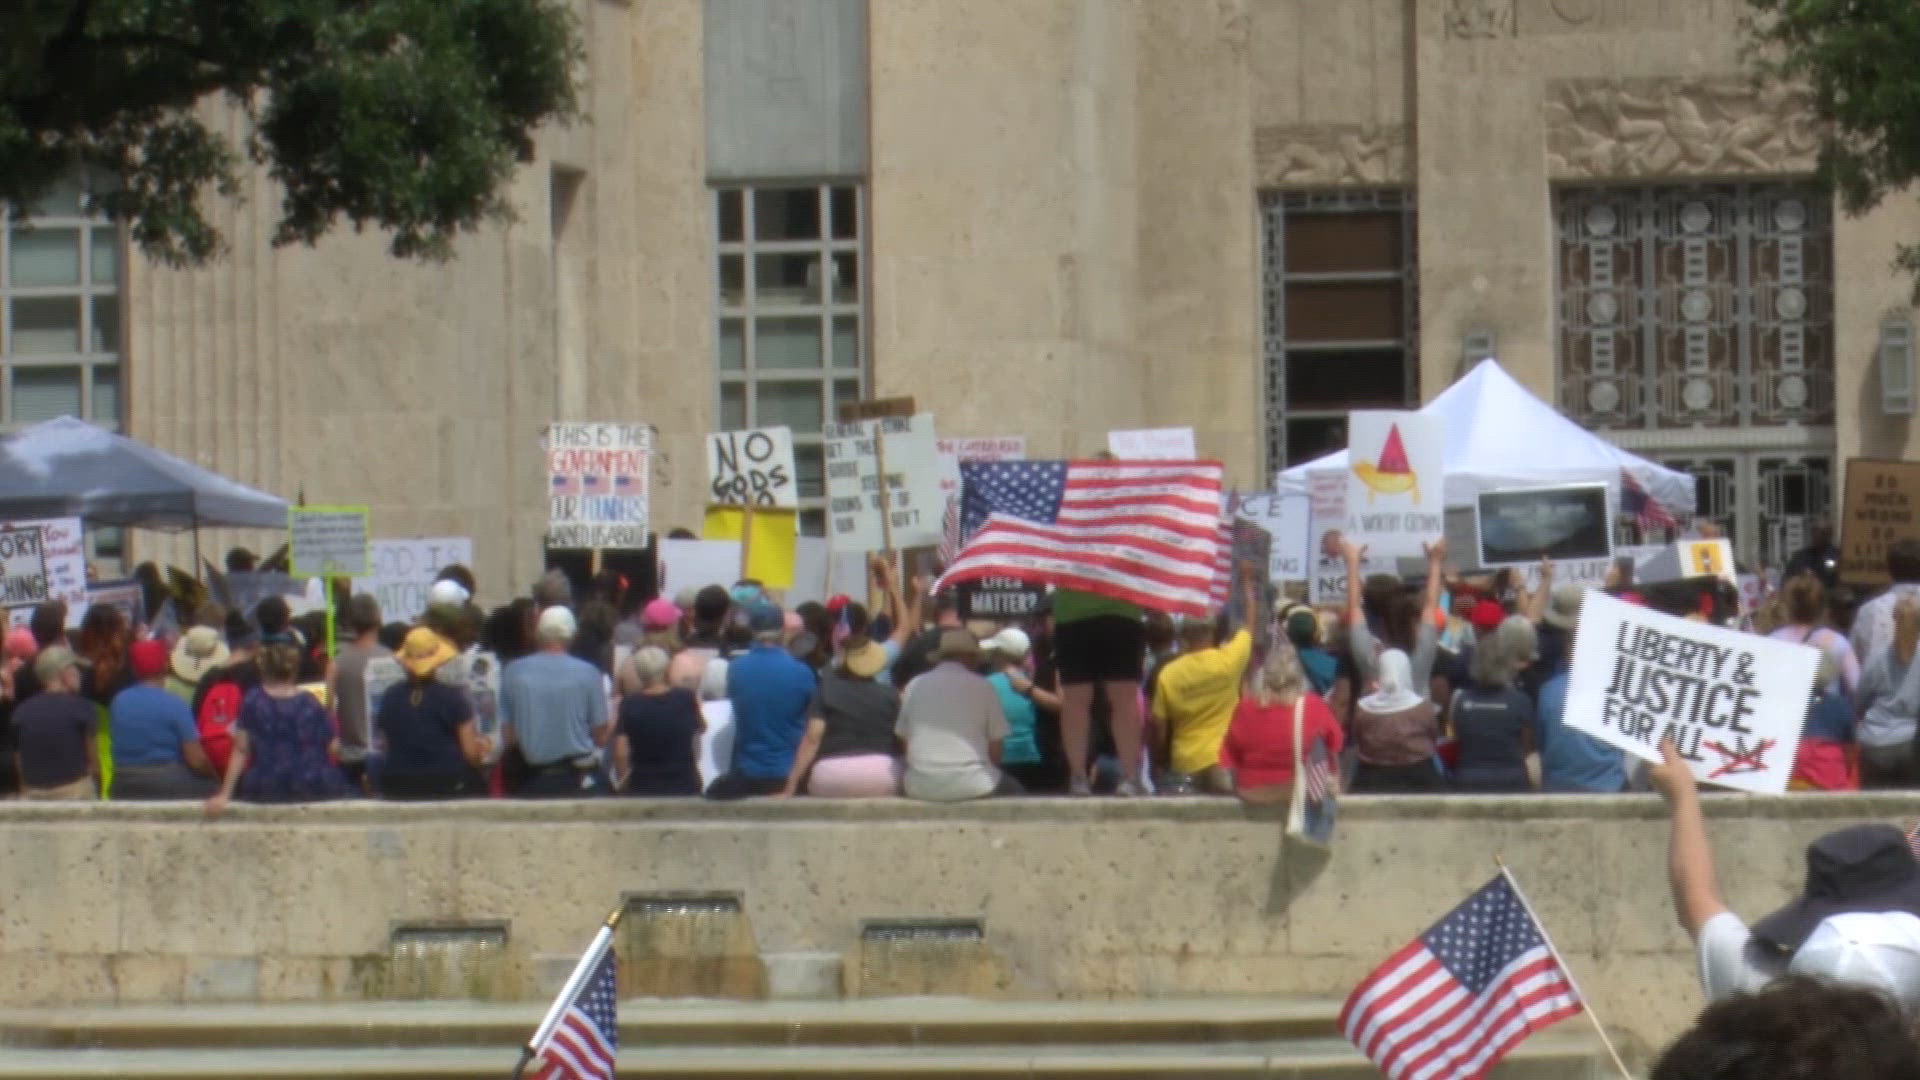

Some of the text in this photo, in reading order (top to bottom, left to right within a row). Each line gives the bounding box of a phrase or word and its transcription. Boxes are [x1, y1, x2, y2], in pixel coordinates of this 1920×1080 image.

[552, 424, 591, 446] THIS
[617, 424, 647, 447] THE
[715, 431, 774, 478] NO
[712, 464, 788, 498] GODS
[0, 532, 37, 559] ORY
[1270, 557, 1298, 574] ING
[970, 592, 1038, 615] MATTER?
[1615, 620, 1756, 686] LIBERTY &
[1604, 655, 1762, 734] JUSTICE
[1602, 699, 1704, 763] FOR ALL
